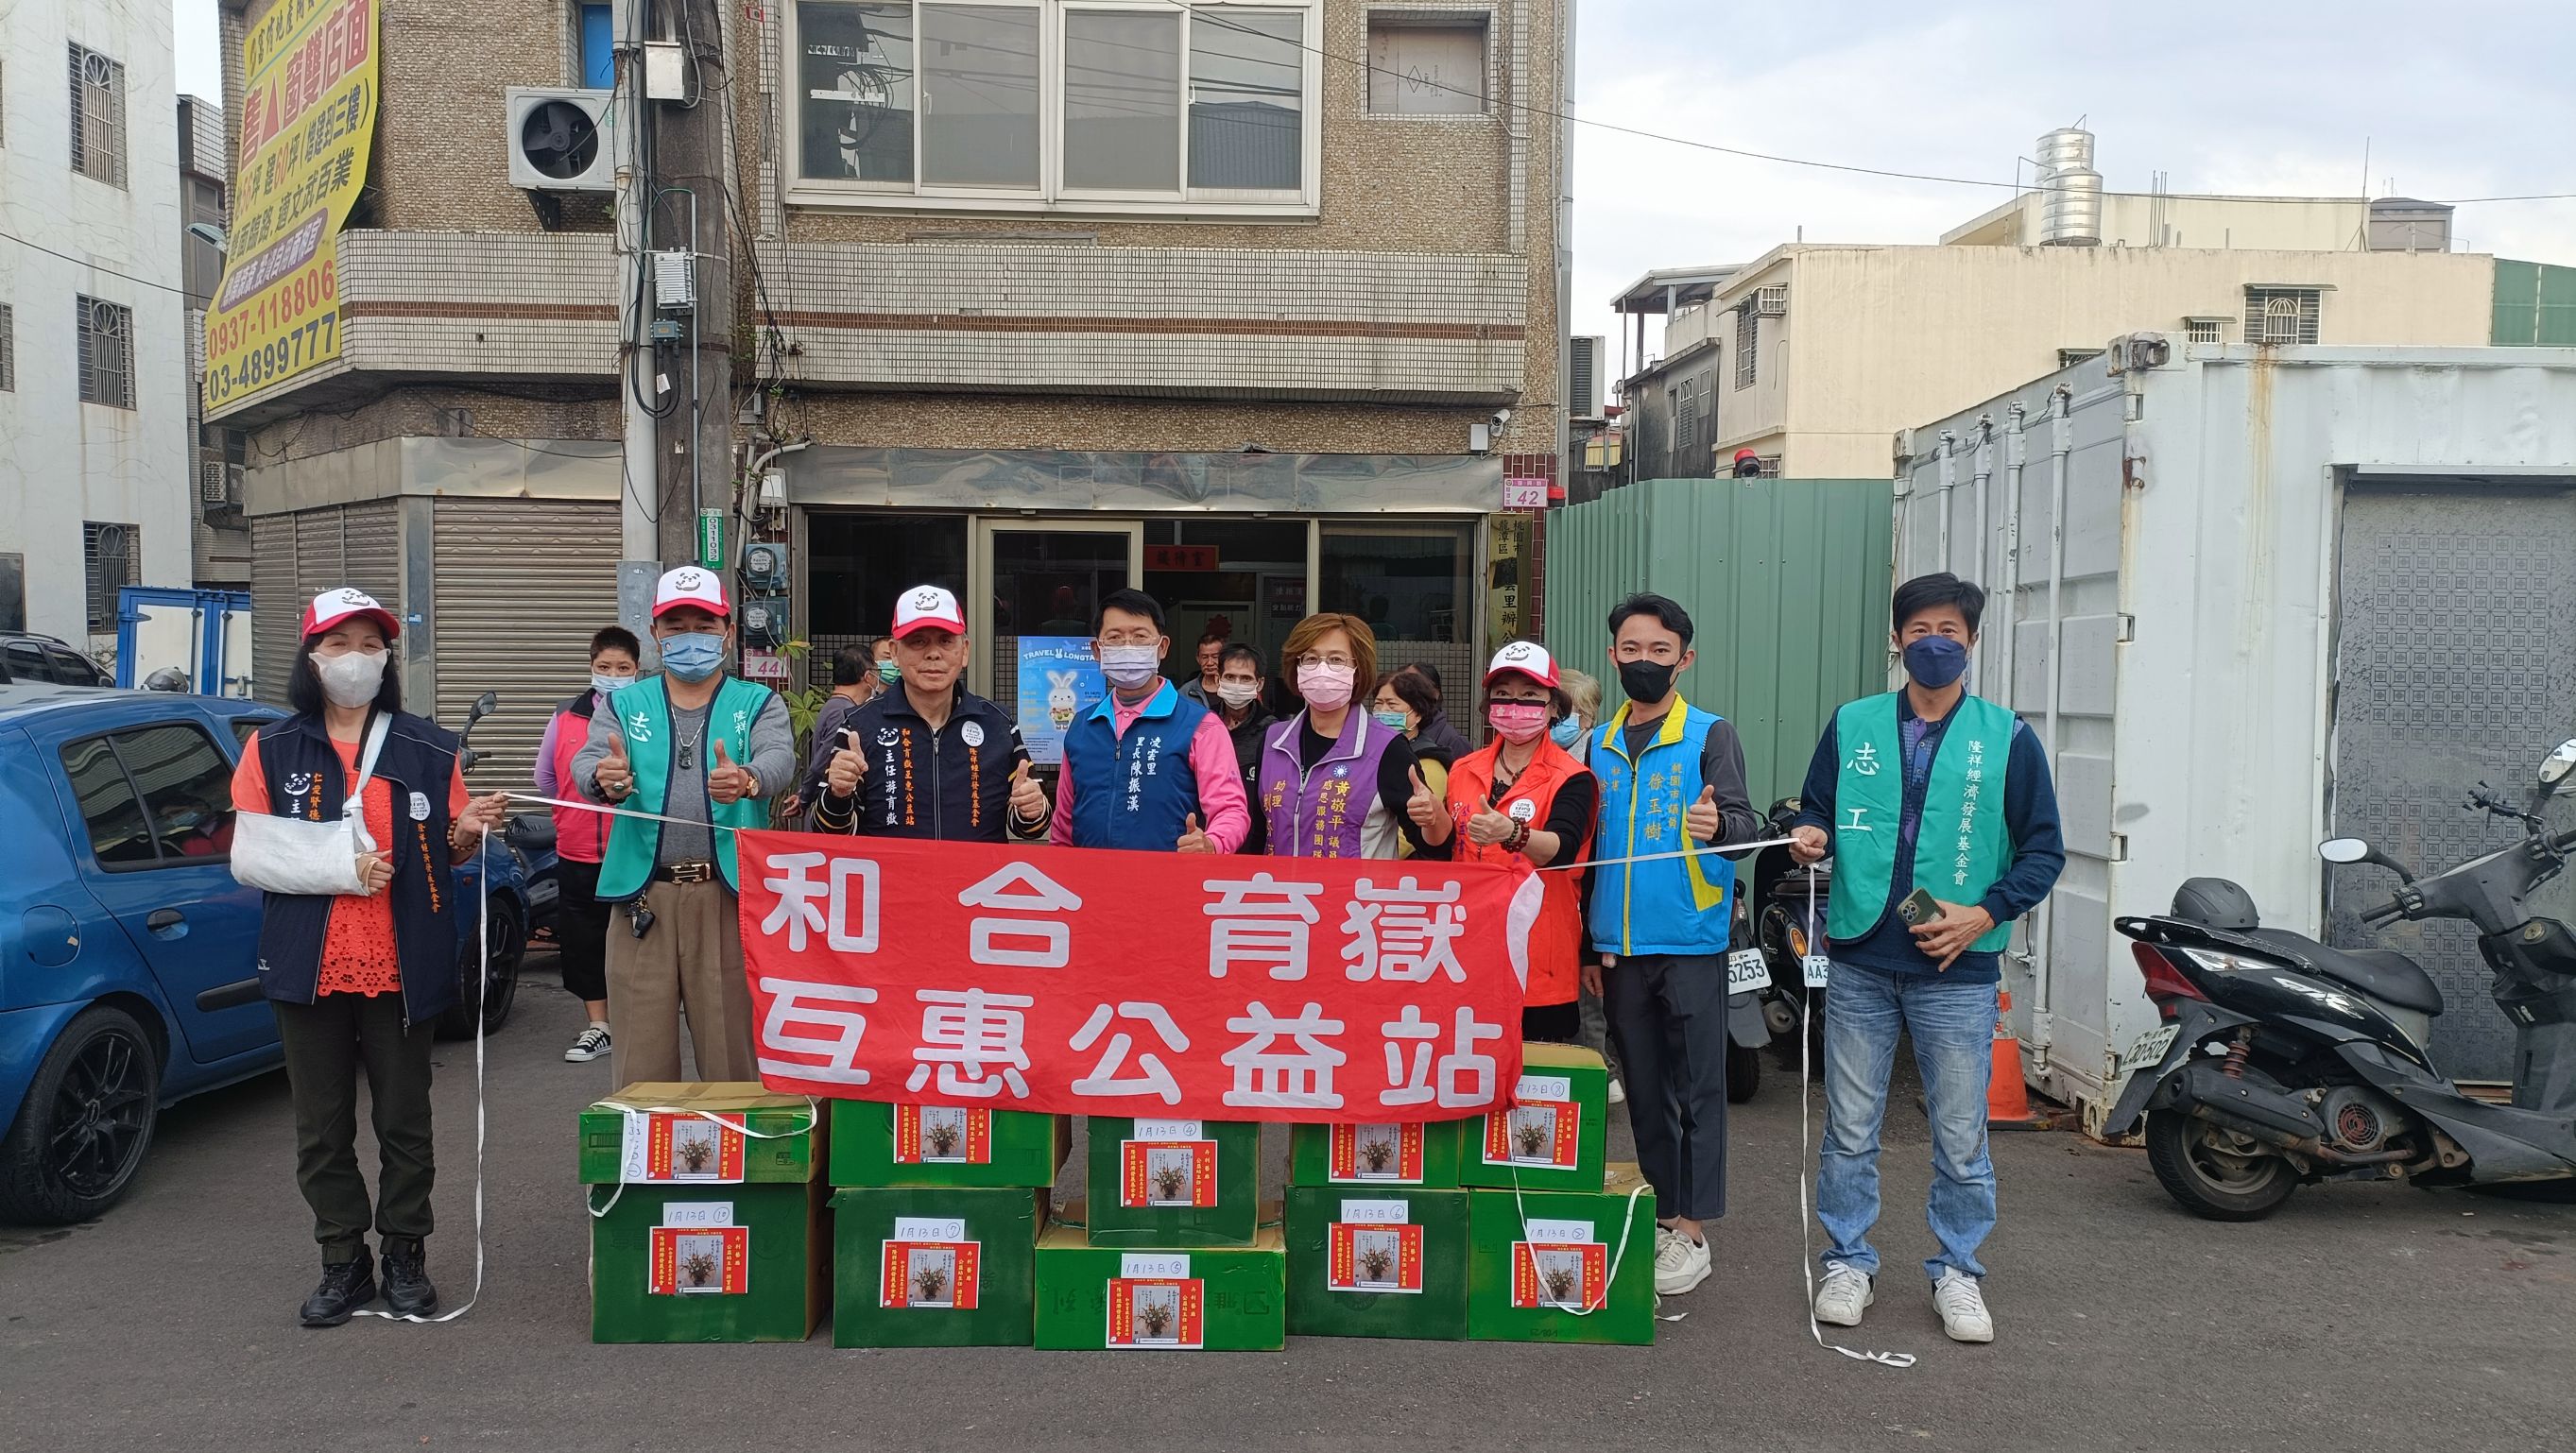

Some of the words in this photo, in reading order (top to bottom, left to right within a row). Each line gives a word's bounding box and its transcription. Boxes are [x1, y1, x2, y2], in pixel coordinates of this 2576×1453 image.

[210, 260, 334, 360] 0937-118806
[210, 310, 335, 402] 03-4899777
[1517, 490, 1539, 505] 42
[1498, 520, 1509, 555] 龍潭區
[1513, 520, 1524, 554] 桃園市
[758, 660, 780, 675] 44
[1022, 649, 1055, 660] TRAVEL
[1146, 737, 1162, 776] 凌雲里
[1838, 742, 1880, 832] 志工
[1952, 740, 1984, 887] 隆祥經濟發展基金會
[758, 976, 1503, 1110] 互惠公益站
